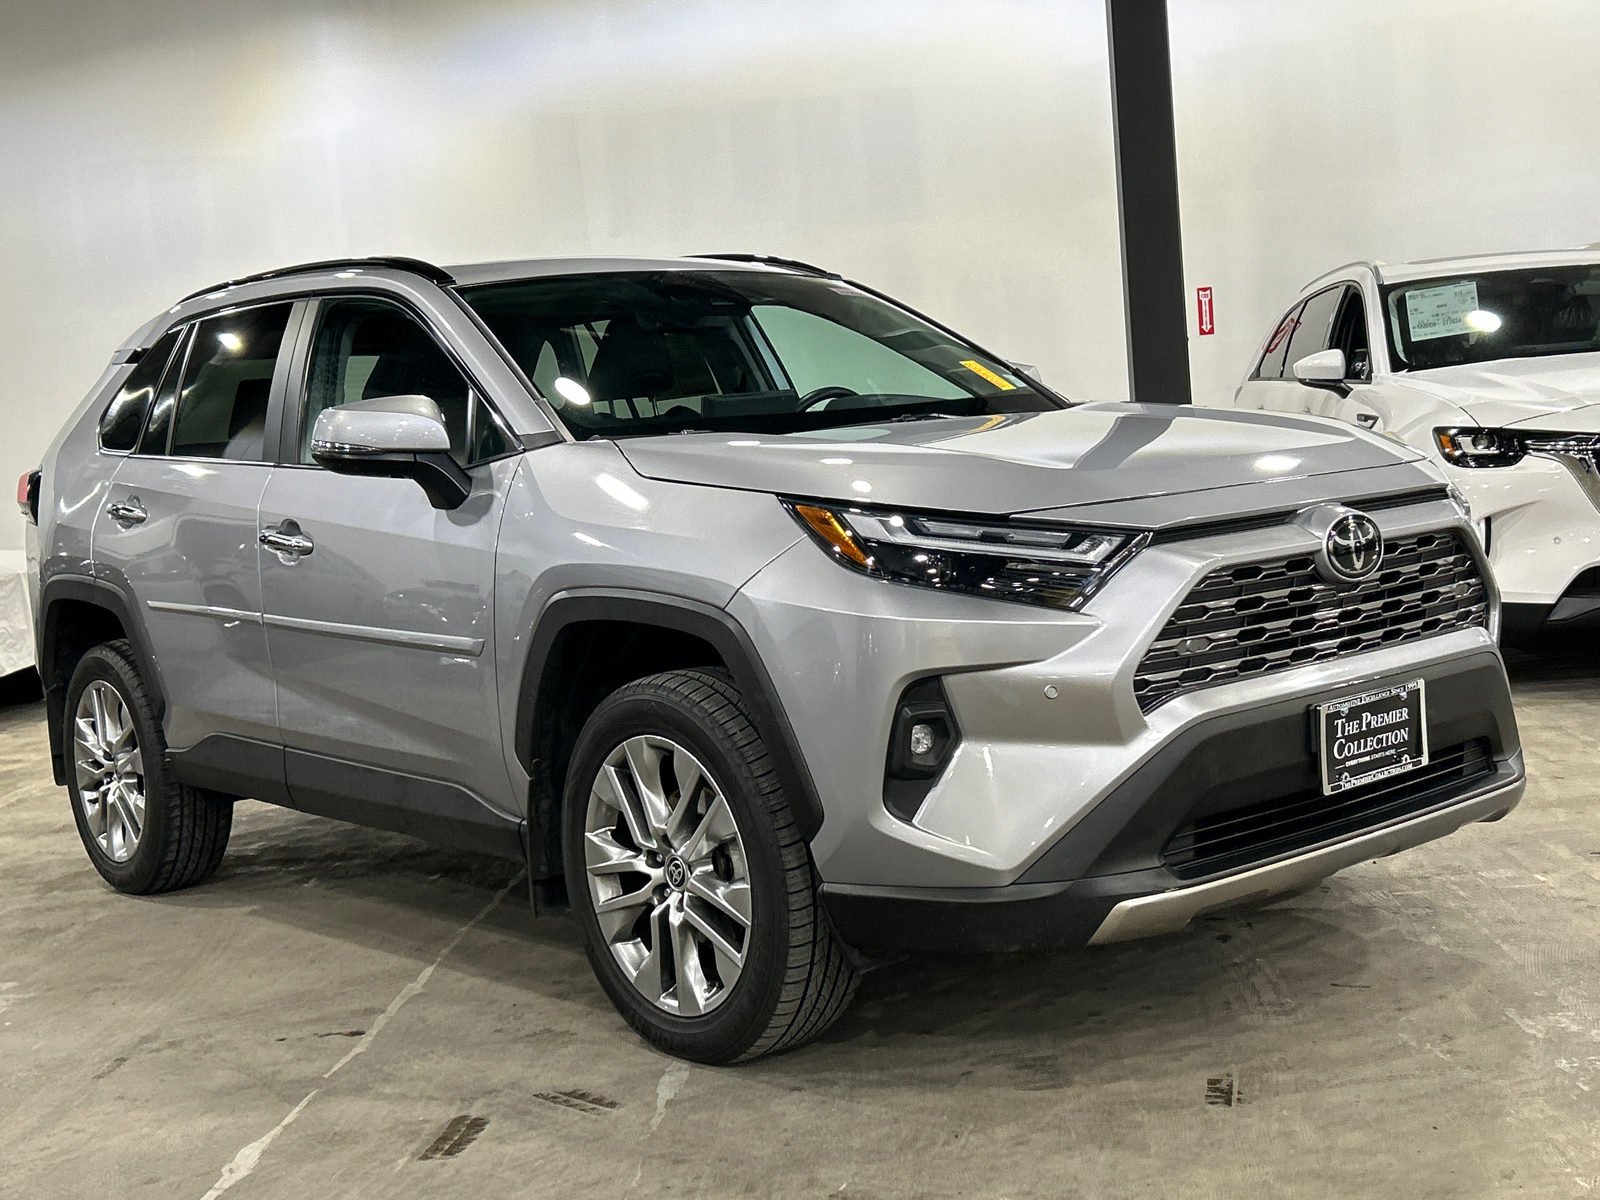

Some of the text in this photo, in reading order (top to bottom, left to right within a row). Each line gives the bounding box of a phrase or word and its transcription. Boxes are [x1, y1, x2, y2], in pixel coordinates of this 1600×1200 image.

[1334, 707, 1409, 738] THE PREMIER
[1333, 727, 1409, 759] COLLECTION
